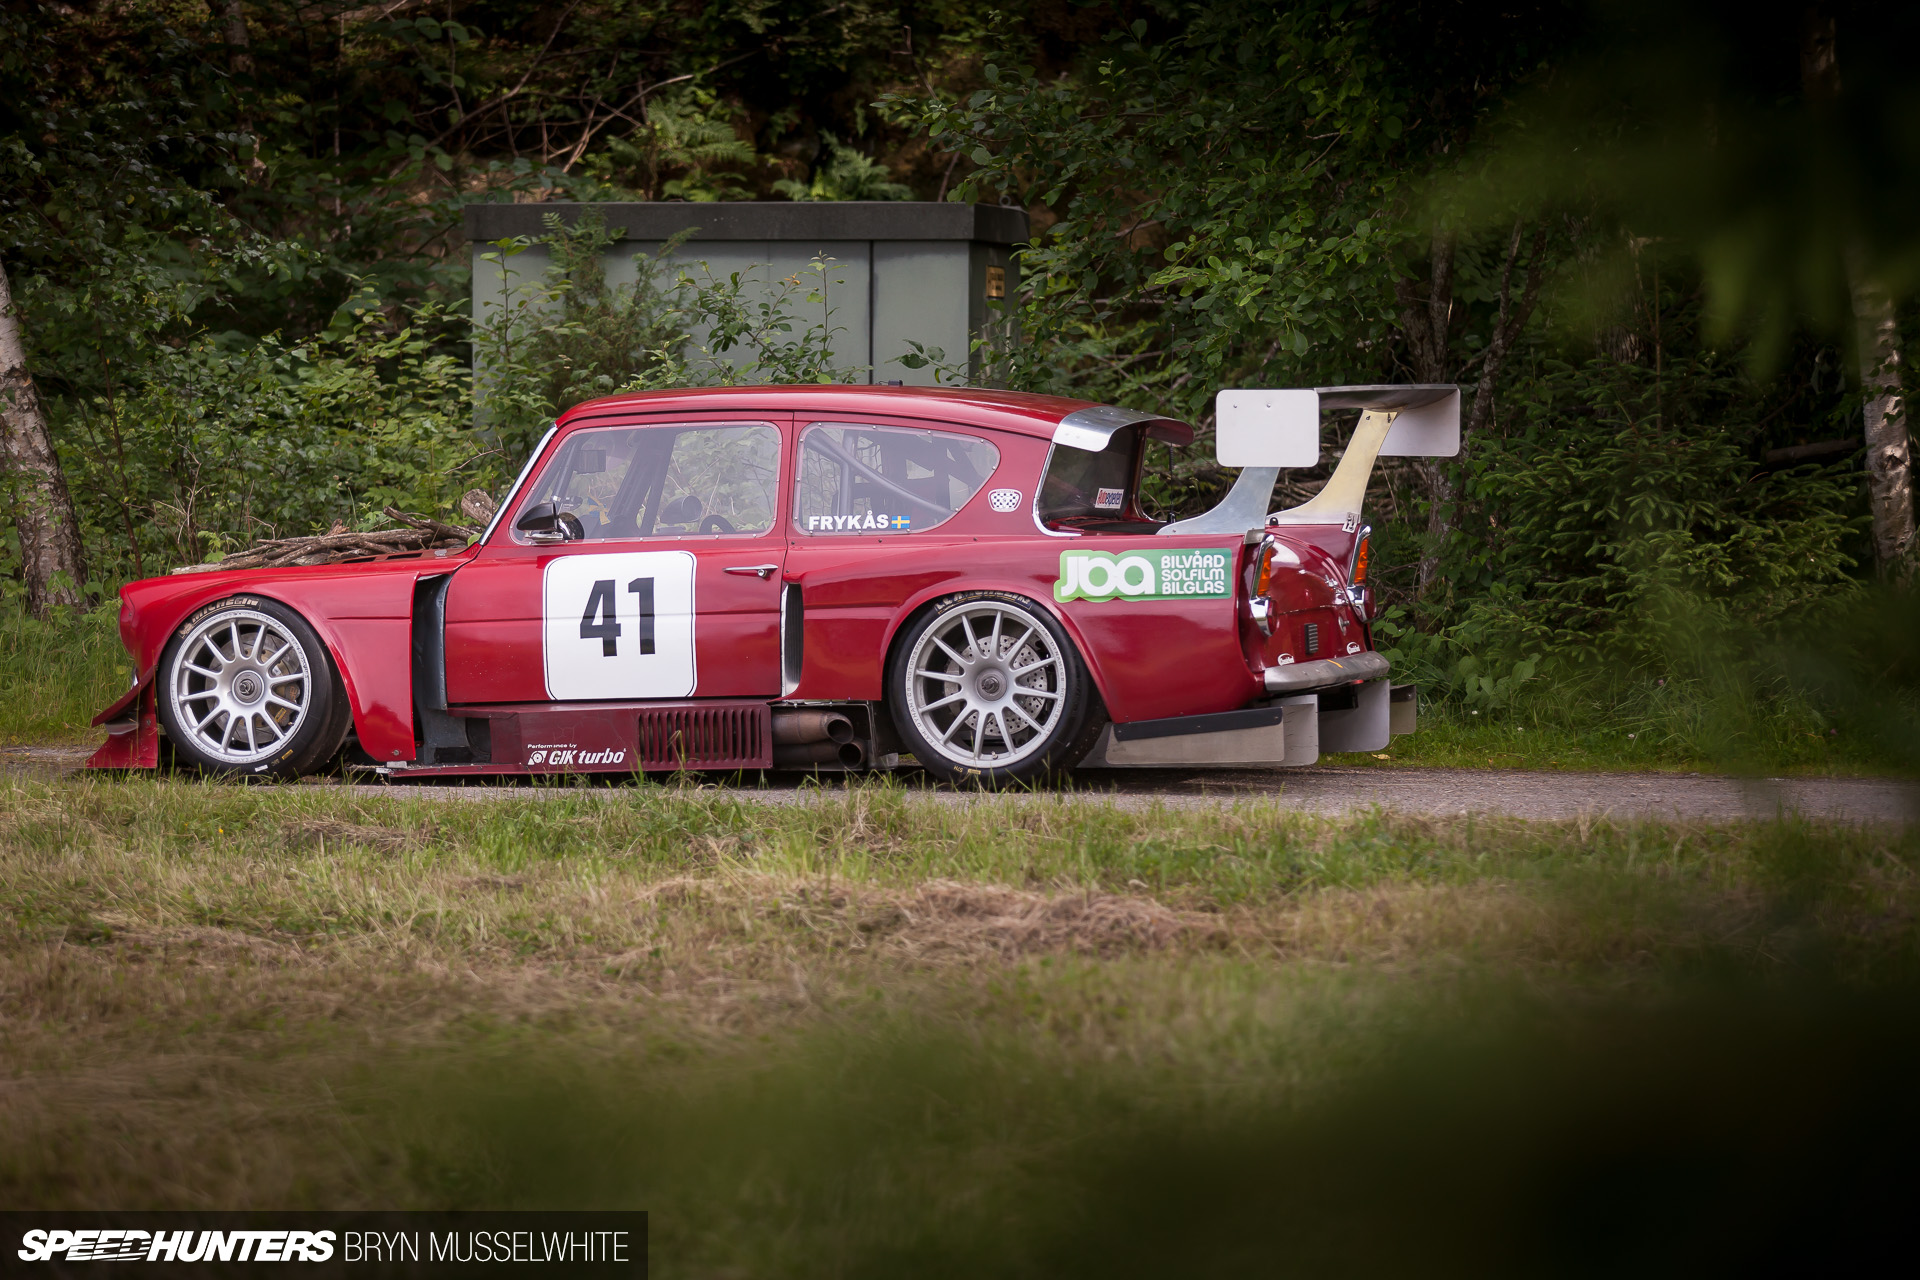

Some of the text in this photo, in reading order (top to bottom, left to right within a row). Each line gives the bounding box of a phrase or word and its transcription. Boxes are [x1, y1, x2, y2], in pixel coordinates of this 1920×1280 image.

[808, 510, 889, 530] FRYKÅS
[1161, 551, 1225, 569] BILVÅRD
[1161, 569, 1225, 581] SOLFILM
[1162, 581, 1225, 594] BILGLAS
[580, 577, 656, 657] 41
[578, 748, 624, 764] turbo
